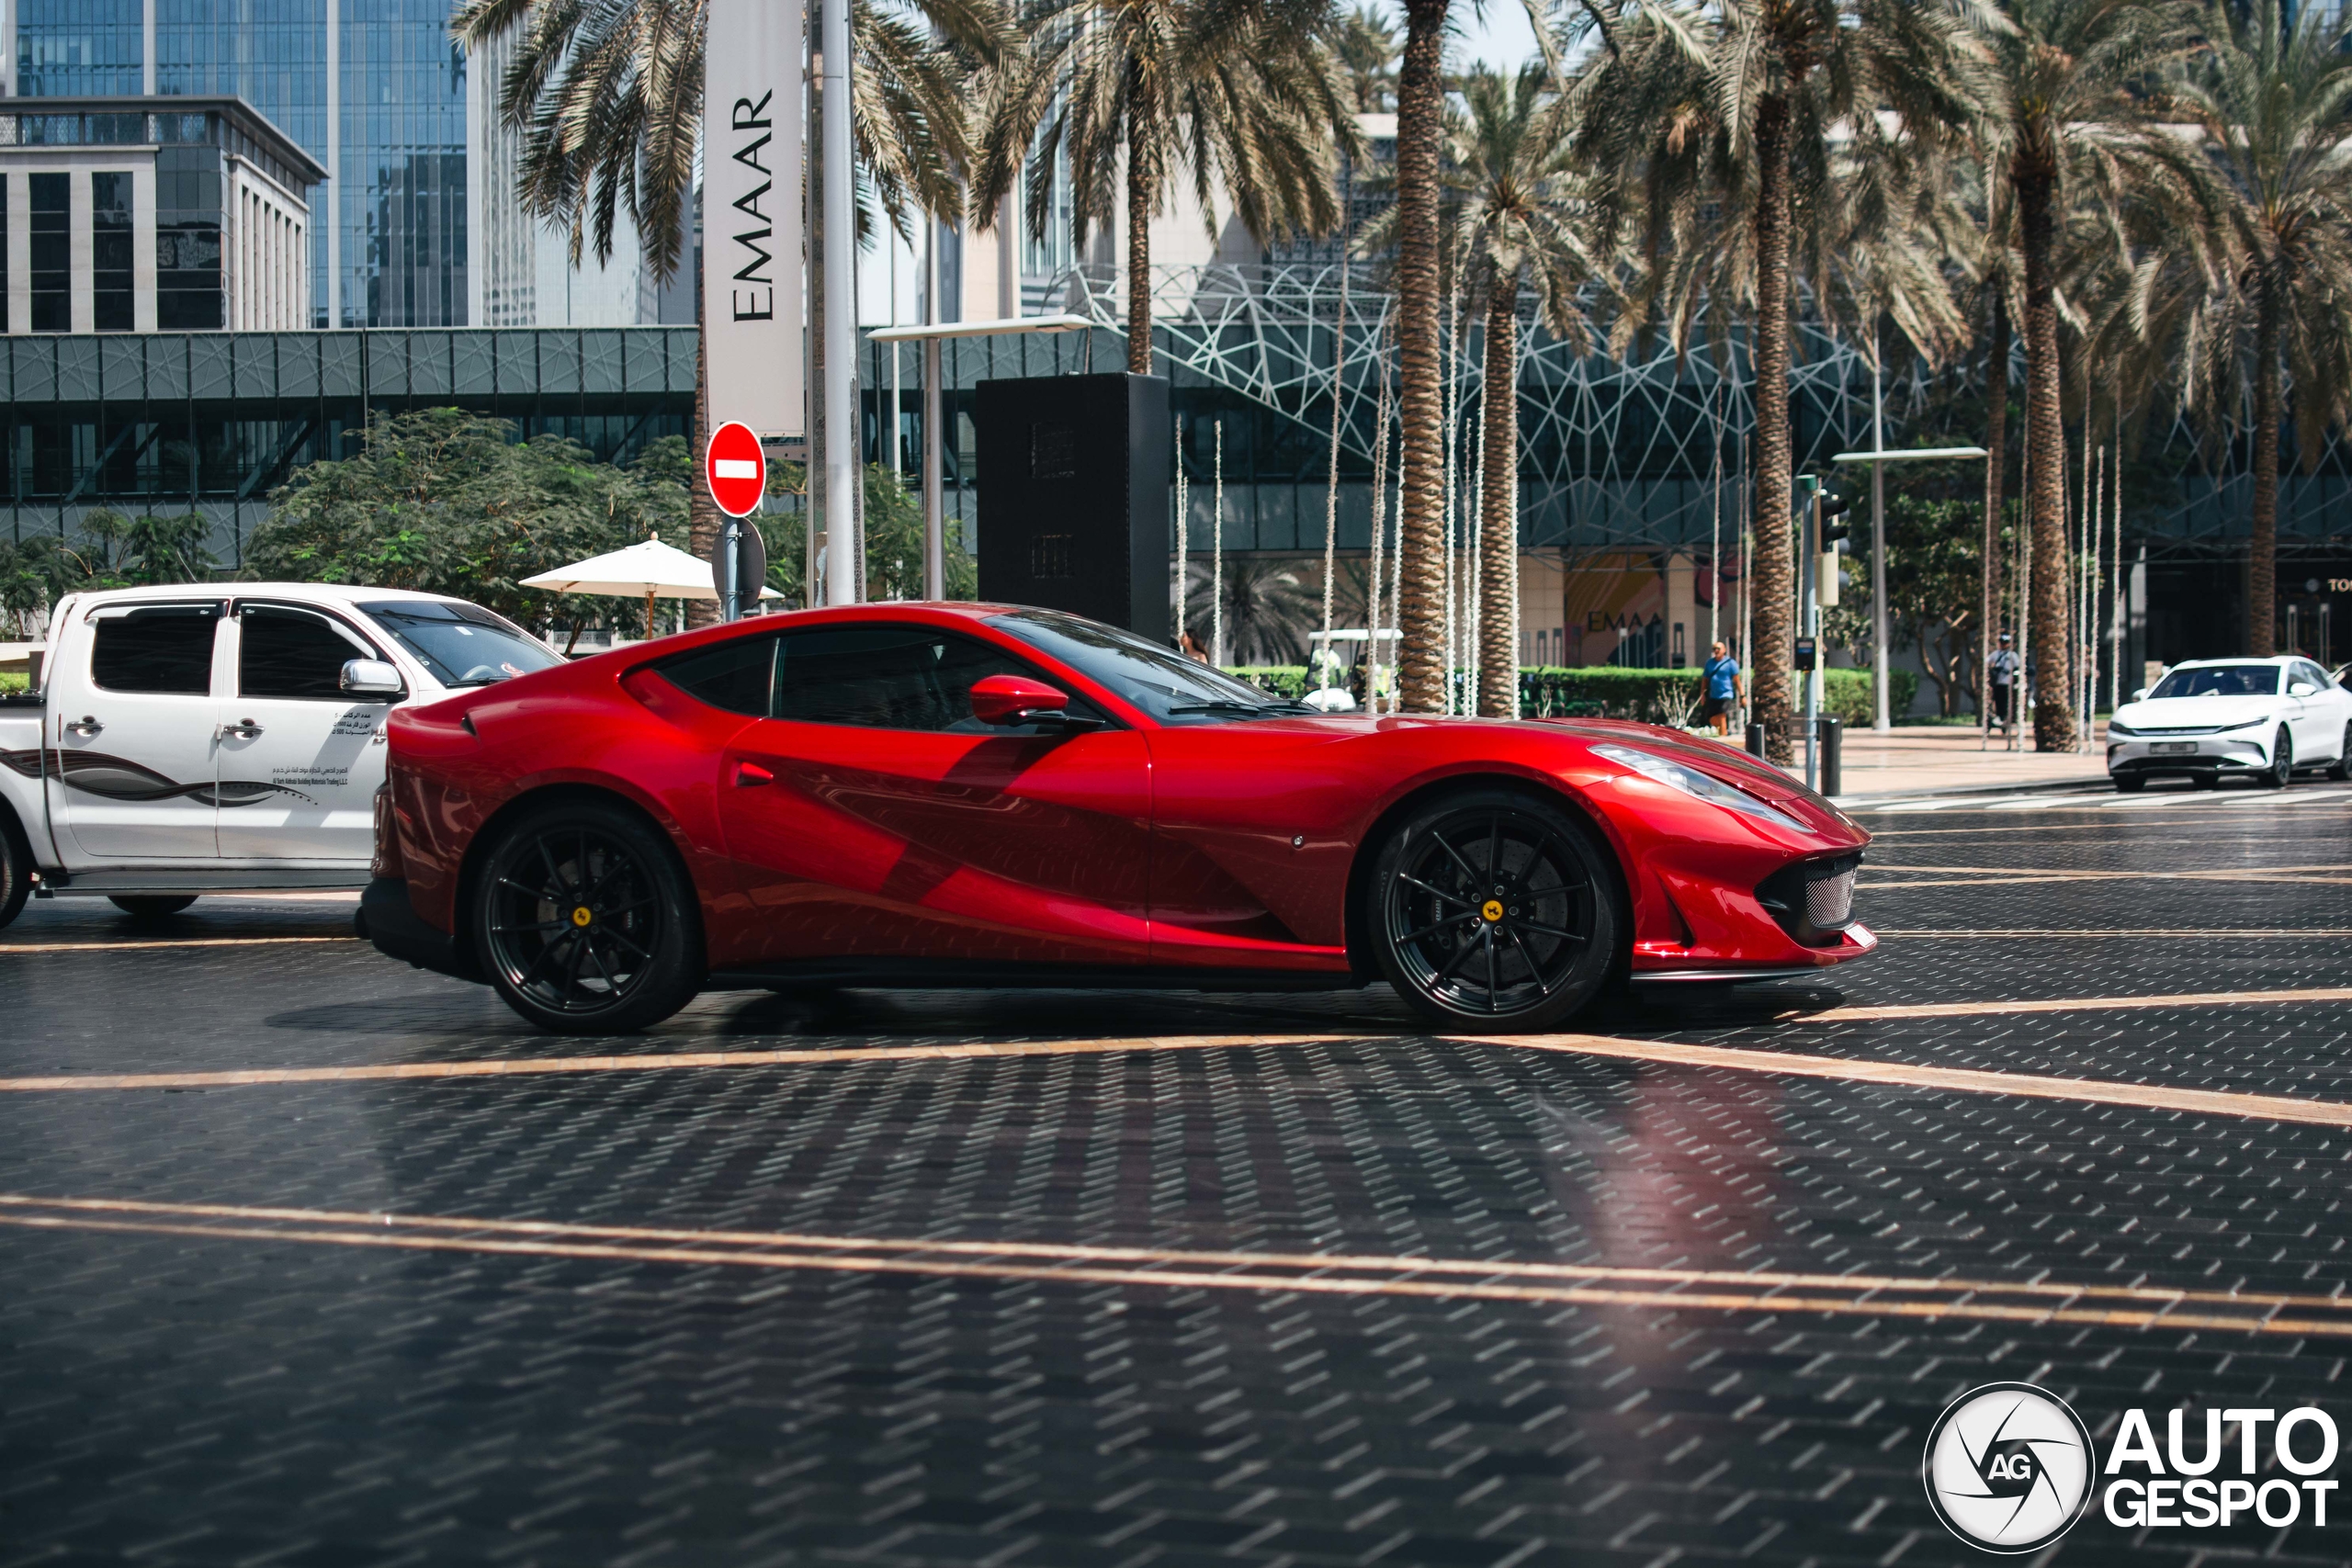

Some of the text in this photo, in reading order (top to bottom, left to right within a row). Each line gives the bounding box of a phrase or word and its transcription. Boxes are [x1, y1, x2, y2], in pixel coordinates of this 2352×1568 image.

[732, 87, 774, 323] EMAAR
[2327, 578, 2352, 593] TO
[1588, 610, 1662, 632] EMAA
[298, 777, 311, 786] Building
[326, 778, 339, 786] Trading
